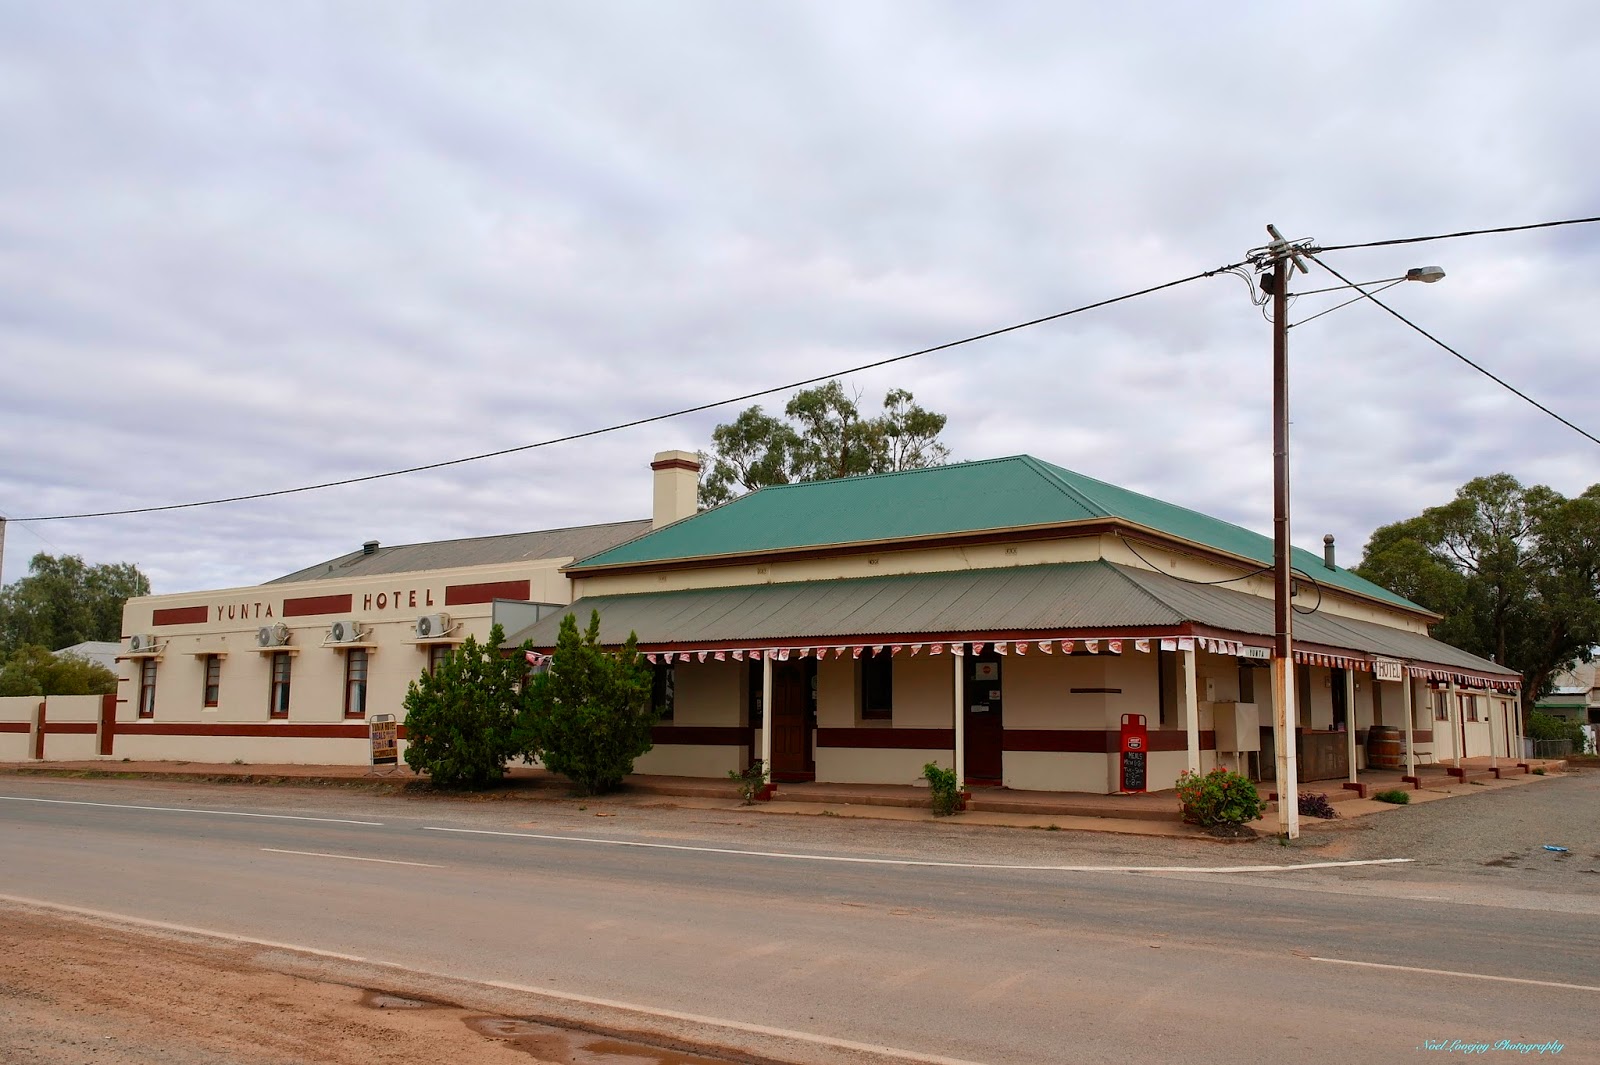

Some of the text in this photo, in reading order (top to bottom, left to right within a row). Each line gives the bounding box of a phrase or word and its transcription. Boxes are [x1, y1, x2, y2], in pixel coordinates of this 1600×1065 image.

[217, 589, 434, 621] YUNTA HOTEL
[1249, 649, 1264, 657] YUNTA
[1378, 660, 1400, 678] HOTEL
